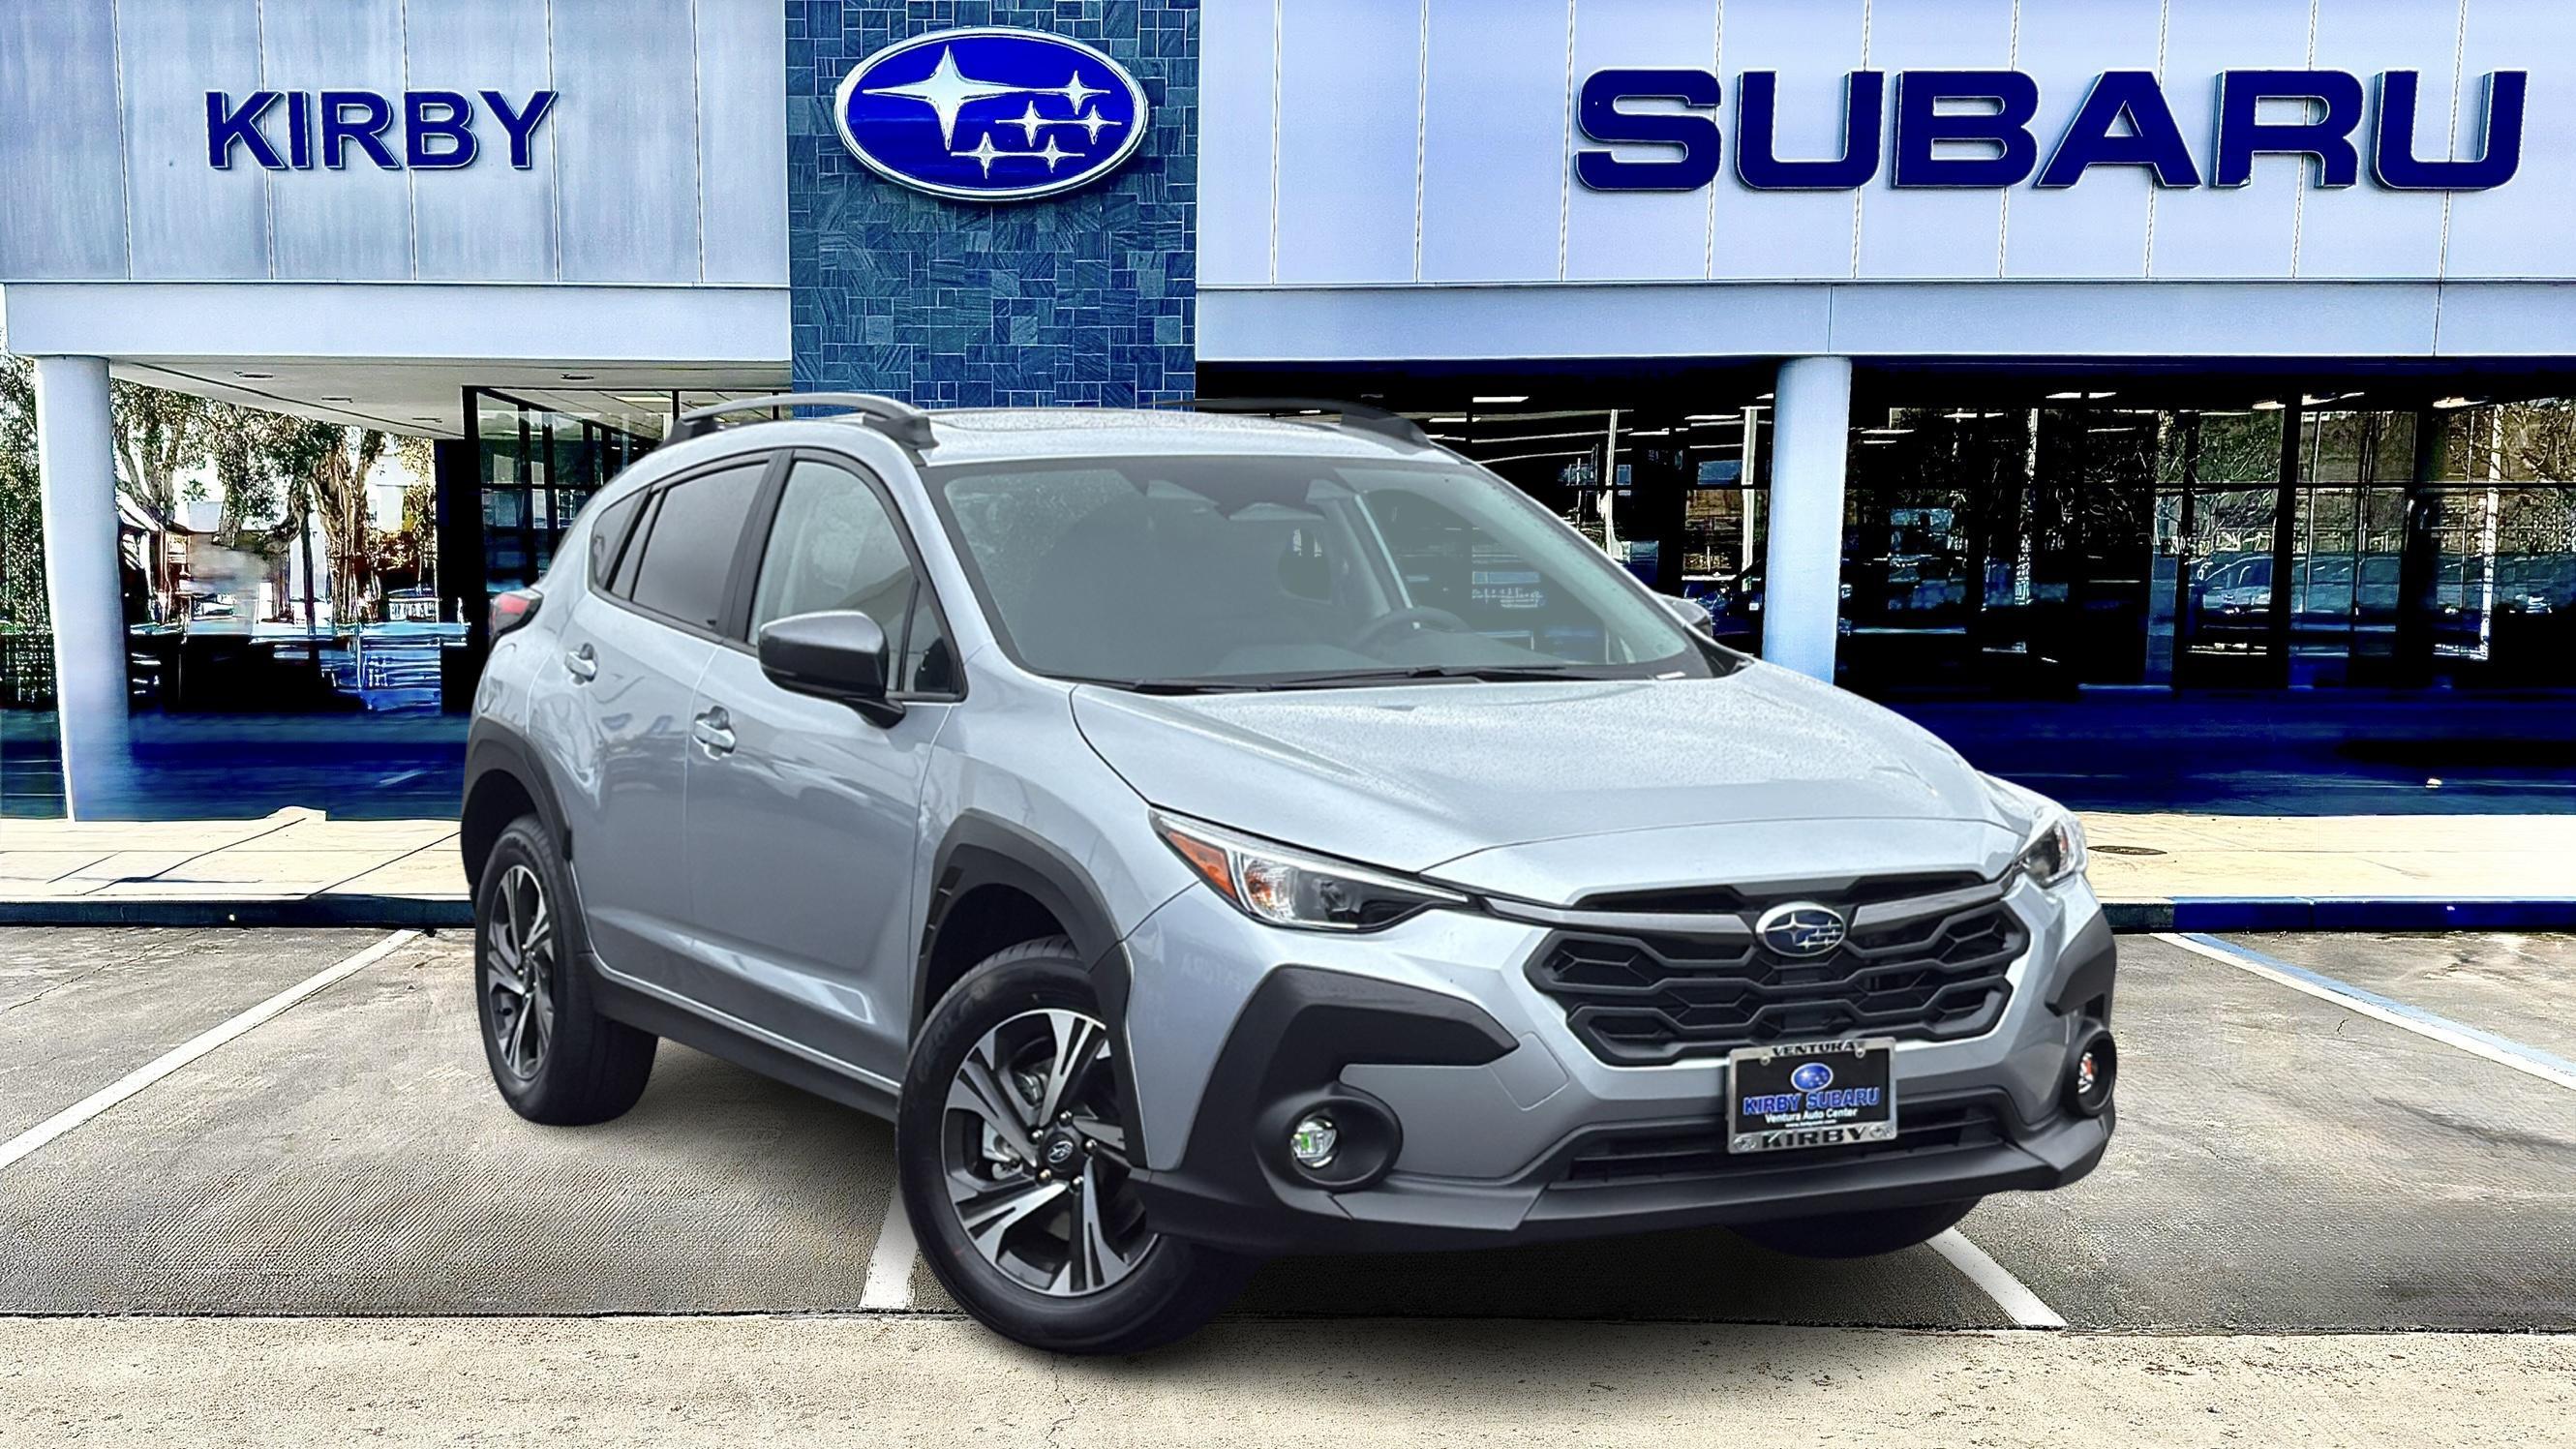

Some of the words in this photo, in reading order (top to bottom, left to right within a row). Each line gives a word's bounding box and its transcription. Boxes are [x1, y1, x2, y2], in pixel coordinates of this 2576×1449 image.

[205, 90, 559, 170] KIRBY
[1574, 70, 2529, 191] SUBARU
[1773, 1041, 1856, 1057] VENTURA
[1743, 1093, 1802, 1115] KIRBY
[1806, 1087, 1880, 1110] SUBARU
[1765, 1112, 1802, 1124] Ventura
[1803, 1110, 1825, 1120] Auto
[1826, 1107, 1858, 1118] Center
[1762, 1126, 1866, 1148] KIRBY
